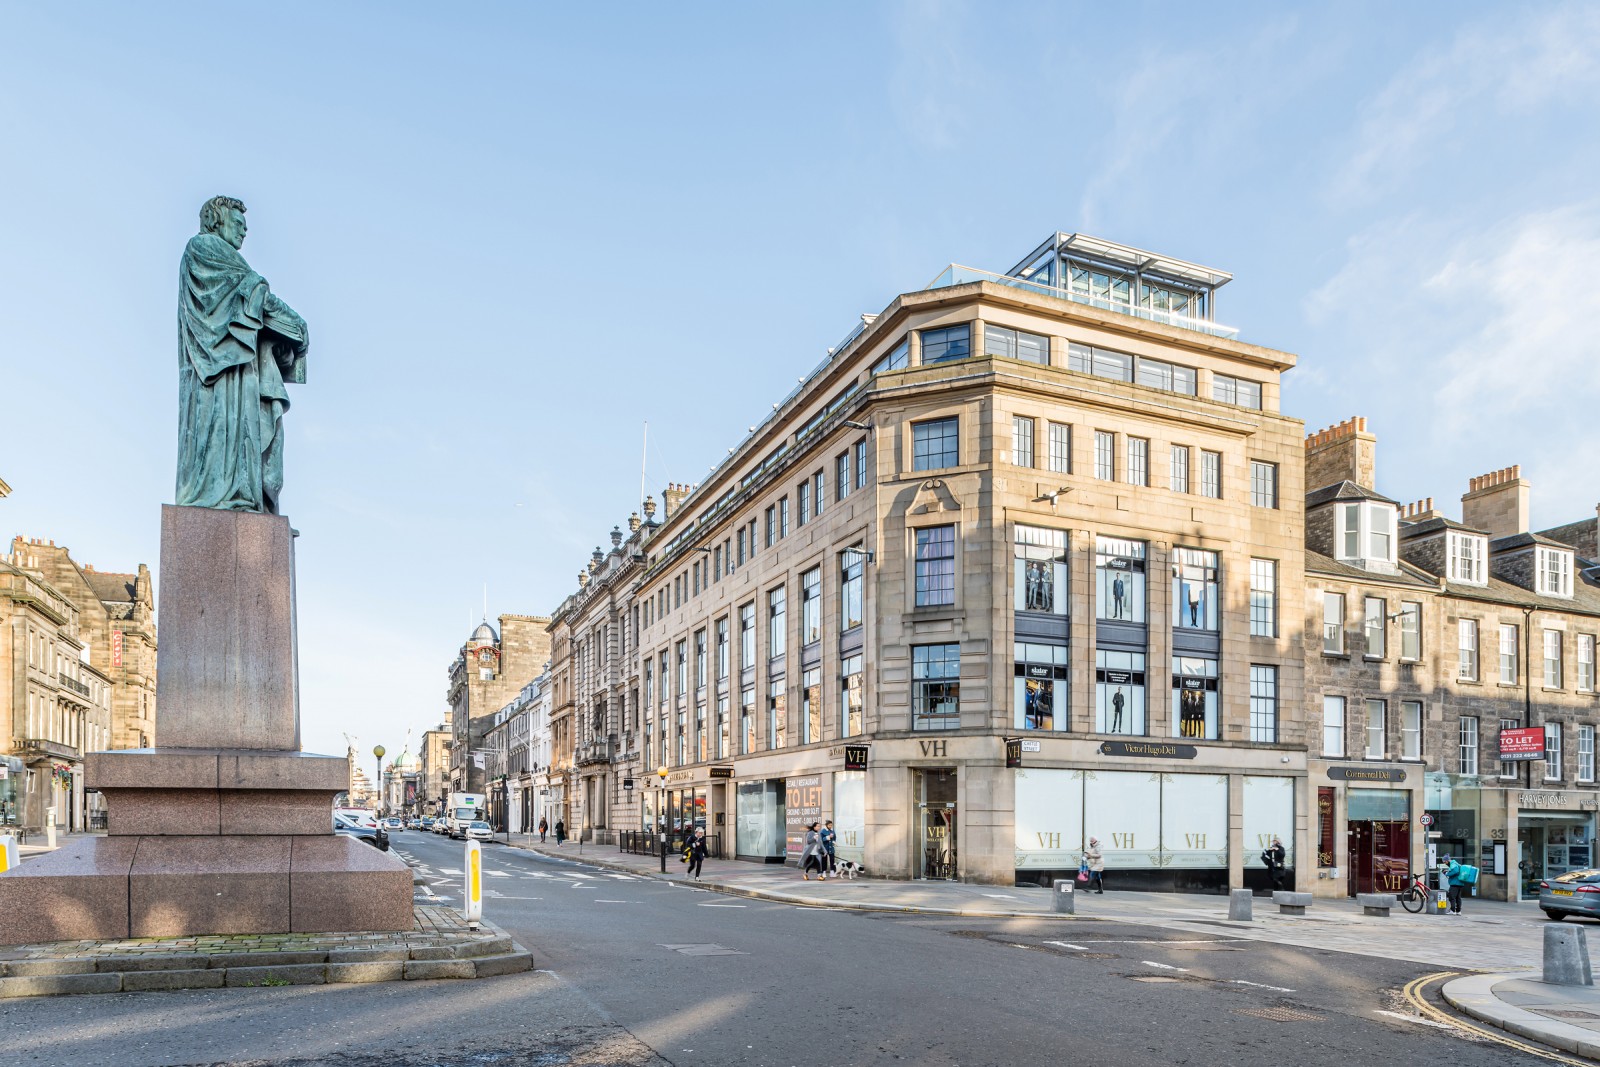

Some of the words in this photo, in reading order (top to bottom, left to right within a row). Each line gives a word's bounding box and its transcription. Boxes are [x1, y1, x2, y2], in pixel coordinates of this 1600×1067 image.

[919, 740, 947, 757] VH
[1008, 746, 1020, 758] VH
[1124, 744, 1142, 753] Victor
[1144, 744, 1162, 756] Hugo
[1162, 746, 1176, 754] Deli
[848, 750, 866, 762] VH
[1346, 770, 1378, 778] Continental
[787, 788, 800, 807] TO
[804, 787, 822, 806] LET
[1519, 794, 1545, 804] HARVEY
[1546, 795, 1567, 805] JONES
[844, 830, 856, 846] VH
[928, 827, 945, 838] VH
[1491, 829, 1504, 838] 33
[1037, 832, 1060, 848] VH
[1112, 833, 1134, 849] VH
[1185, 833, 1206, 849] VH
[1383, 875, 1401, 889] VH
